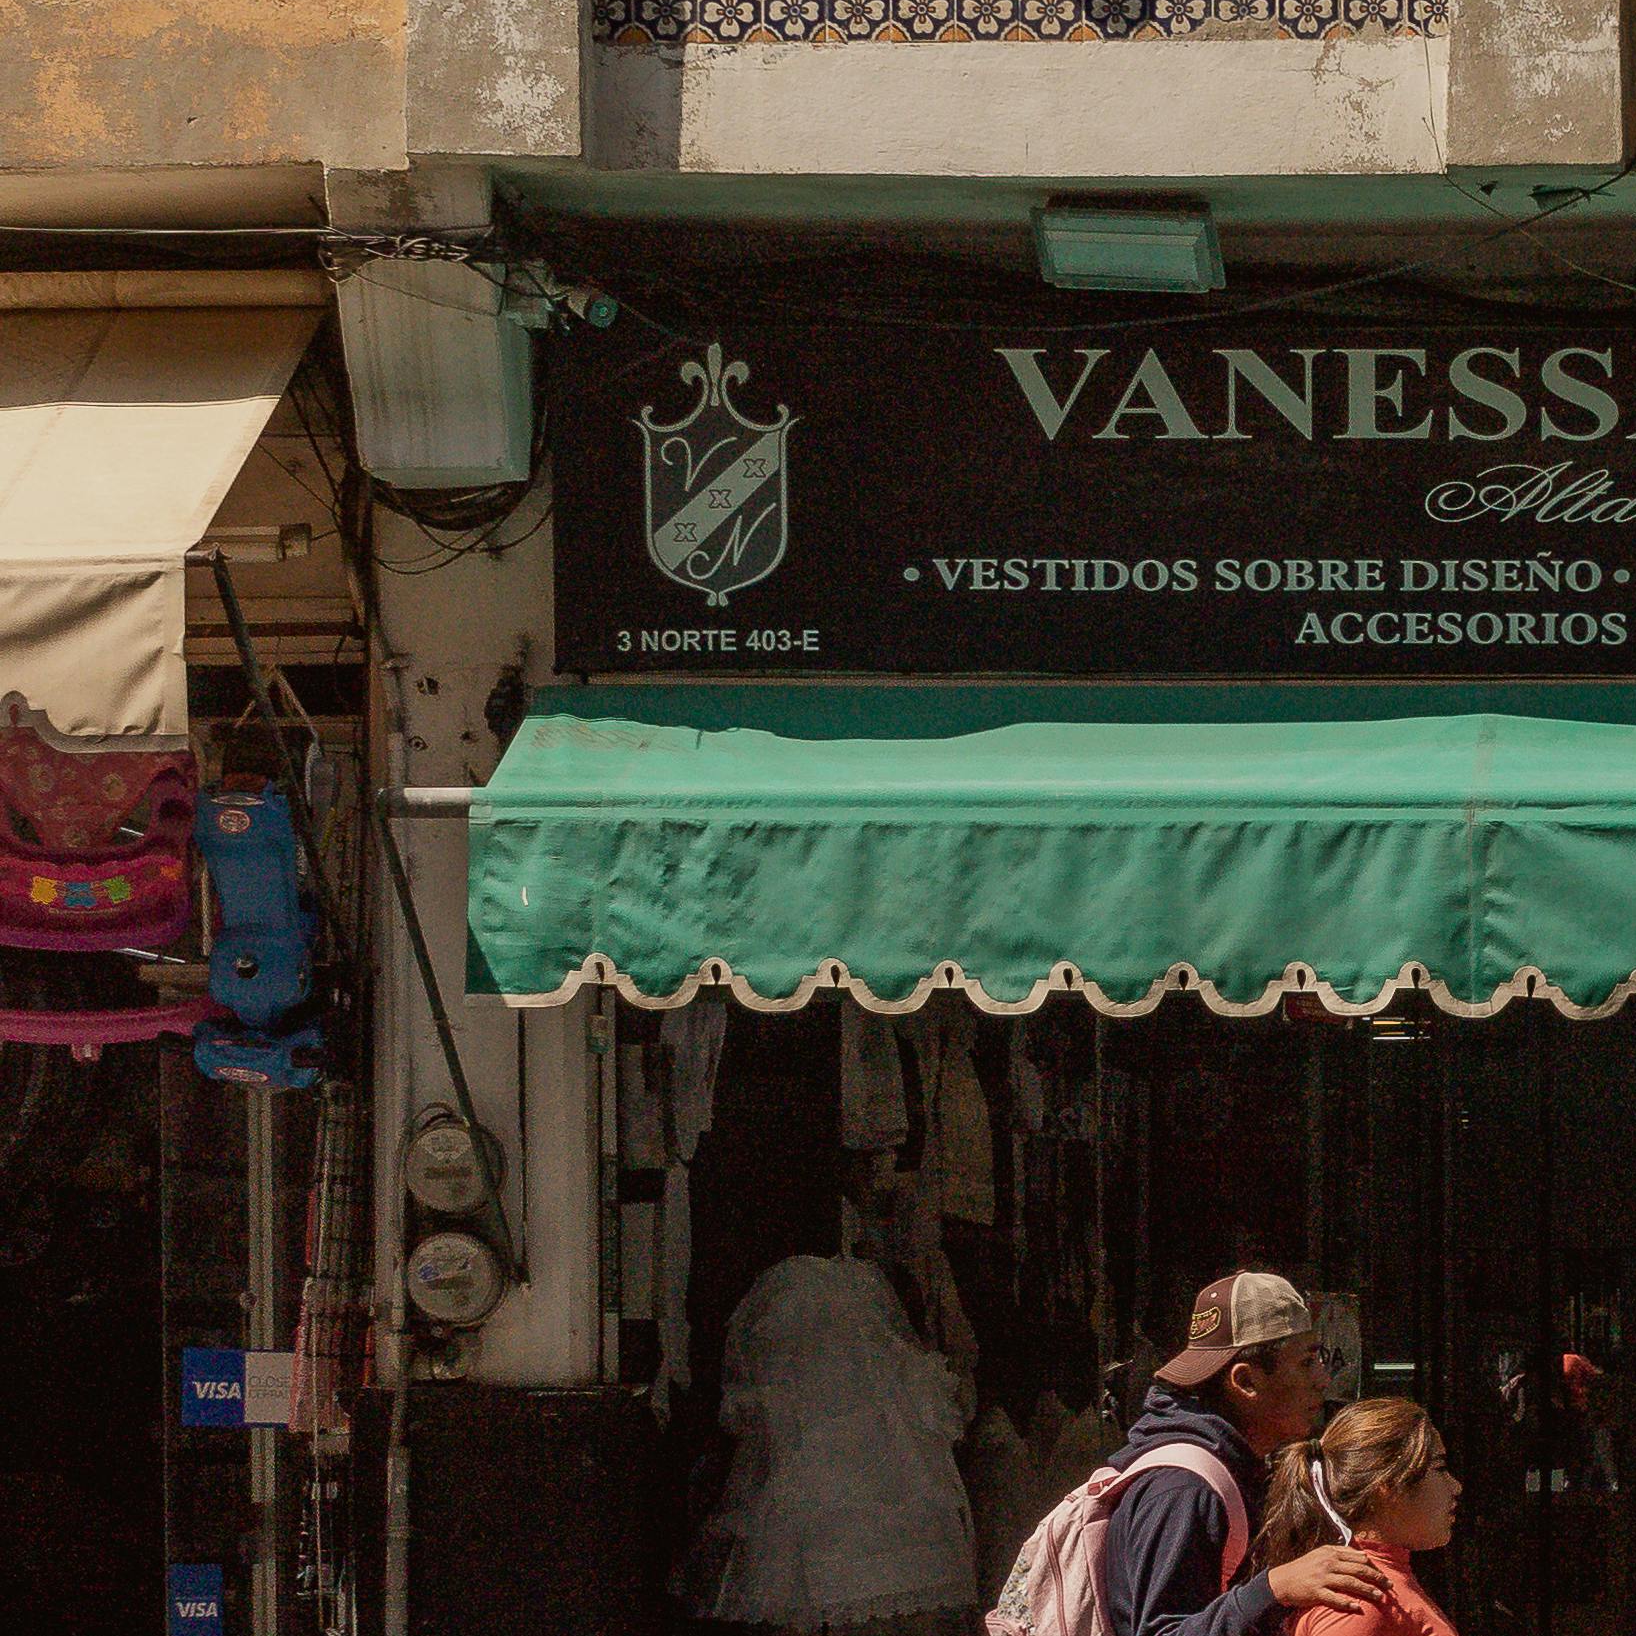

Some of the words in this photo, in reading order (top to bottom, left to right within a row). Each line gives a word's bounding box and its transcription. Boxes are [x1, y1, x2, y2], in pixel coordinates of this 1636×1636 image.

[931, 557, 1200, 593] VESTIDOS
[1214, 558, 1386, 593] SOBRE
[1399, 550, 1603, 593] DISEÑO
[616, 629, 633, 653] 3
[640, 629, 738, 652] NORTE
[744, 628, 820, 652] 403-E
[1294, 611, 1628, 646] ACCESORIOS
[192, 1381, 242, 1400] VISA
[175, 1601, 218, 1618] VISA
